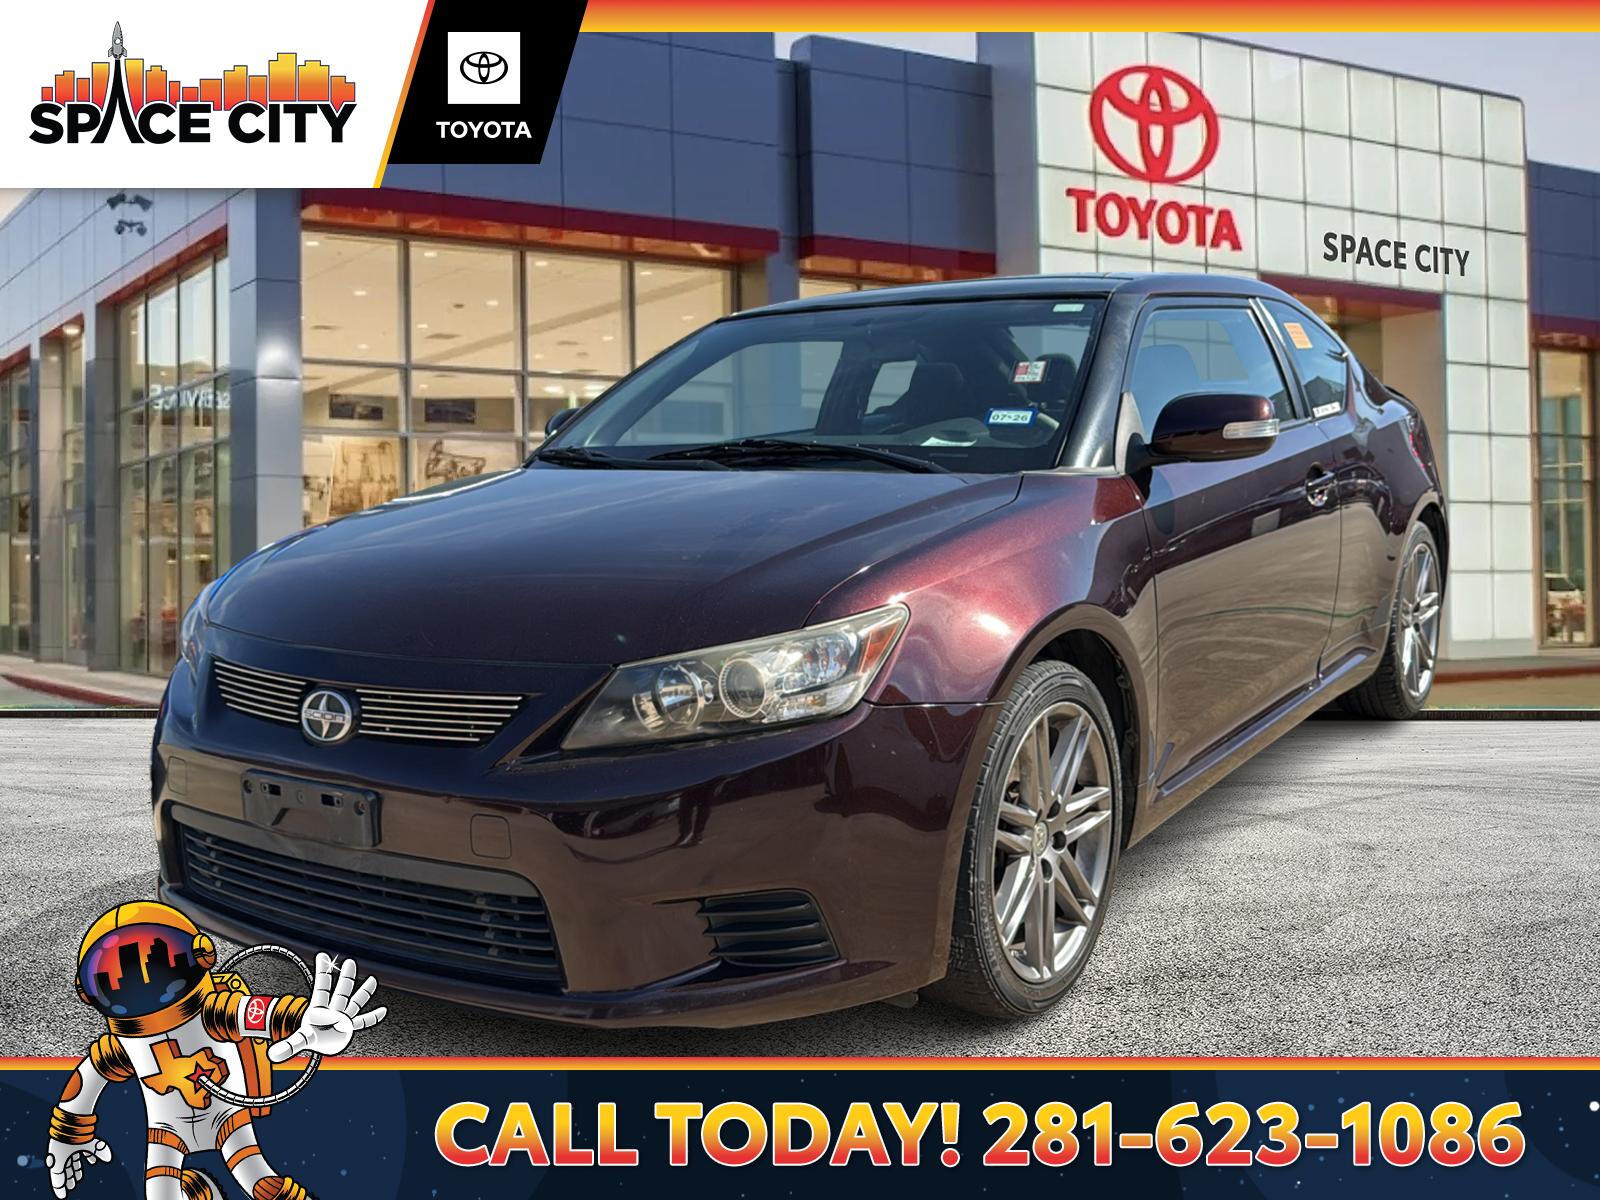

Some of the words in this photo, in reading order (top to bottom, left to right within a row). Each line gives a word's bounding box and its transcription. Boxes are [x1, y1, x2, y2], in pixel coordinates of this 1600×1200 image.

[1066, 187, 1242, 252] TOYOTA
[1323, 231, 1407, 270] SPACE
[1415, 245, 1470, 277] CITY
